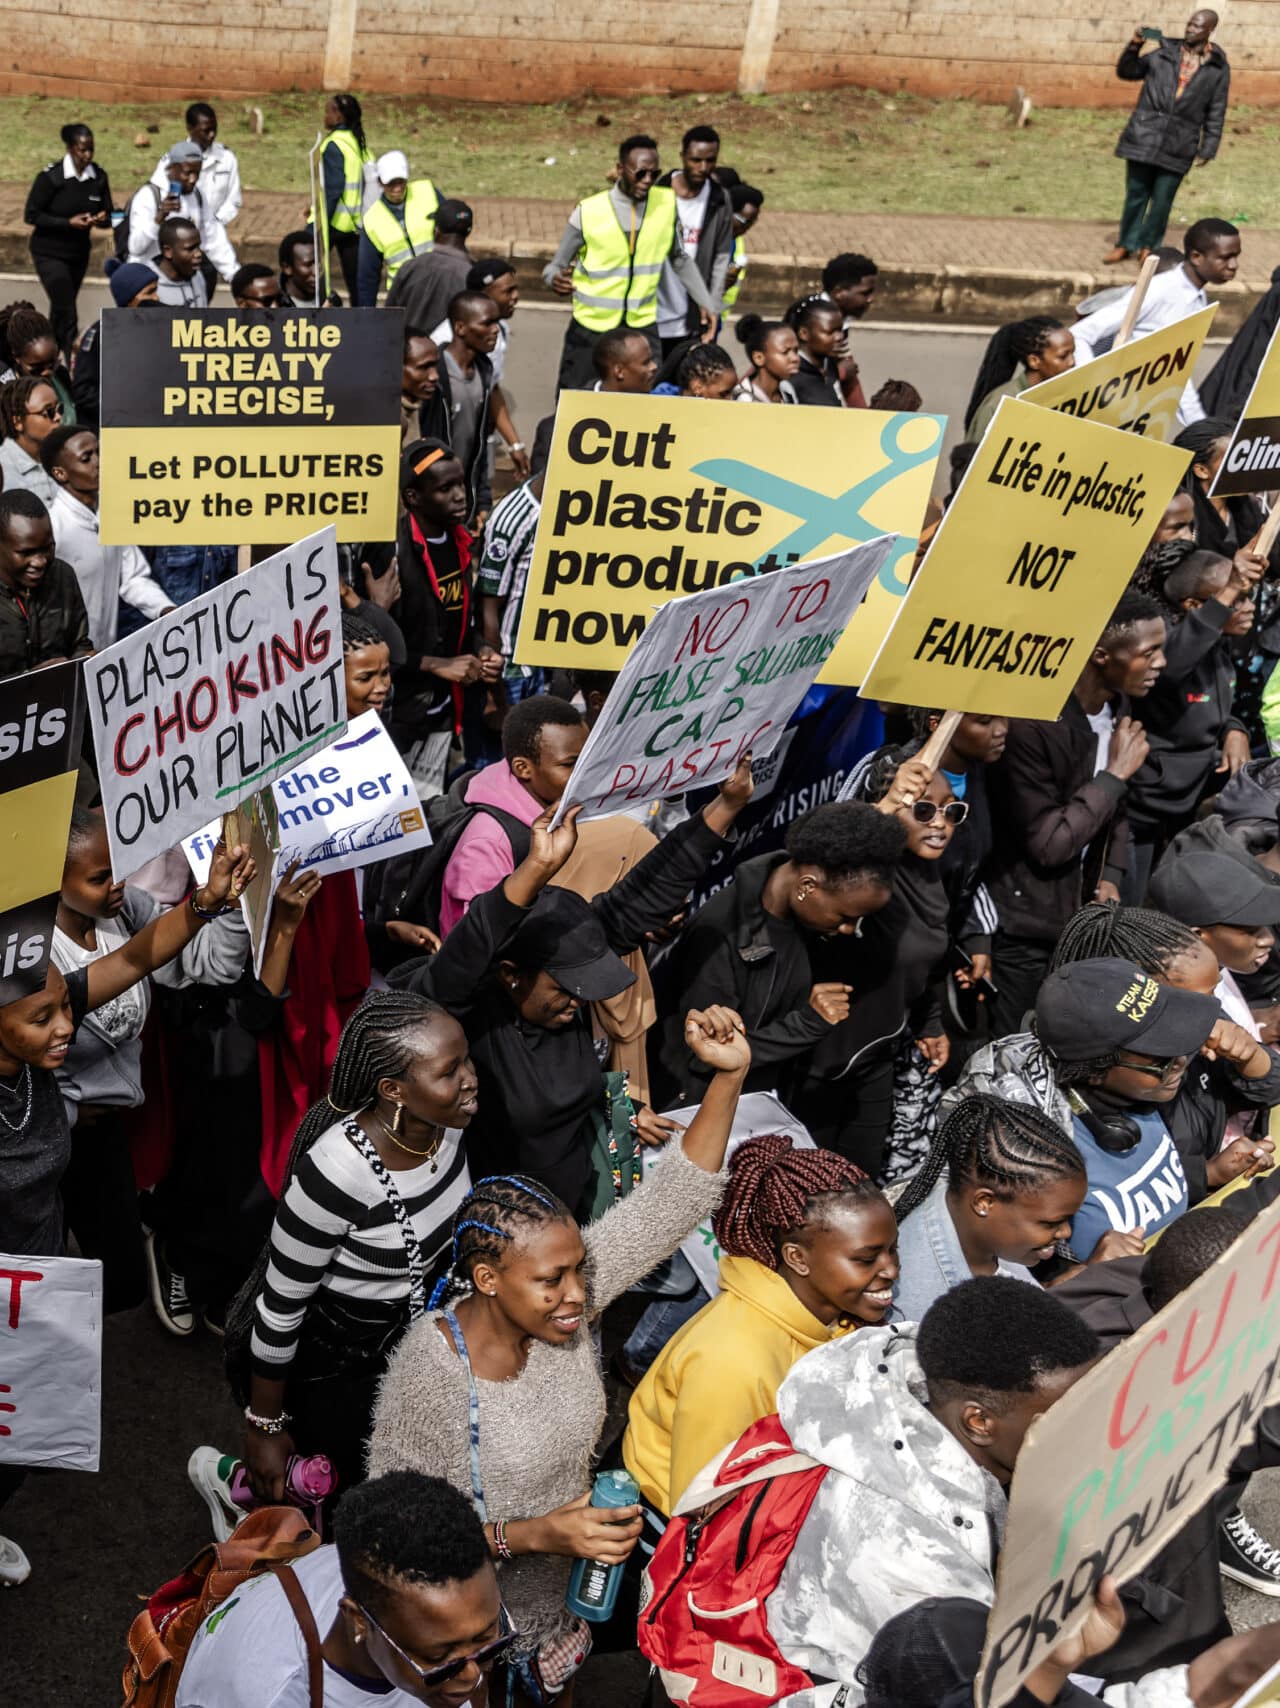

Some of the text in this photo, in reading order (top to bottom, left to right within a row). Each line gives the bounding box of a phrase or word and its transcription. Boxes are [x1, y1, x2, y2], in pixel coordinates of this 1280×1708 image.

[171, 317, 342, 349] Make the
[179, 352, 332, 382] TREATY
[163, 386, 335, 421] PRECISE,
[128, 453, 384, 480] Let POLLUTERS
[567, 417, 676, 469] Cut
[132, 491, 369, 524] pay the PRICE!
[553, 479, 763, 536] plastic
[987, 437, 1146, 527] Life in plastic,
[1006, 541, 1077, 592] NOT
[96, 546, 328, 727] PLASTIC IS
[674, 579, 831, 663] NO TO
[913, 617, 1075, 680] FANTASTIC!
[113, 604, 332, 777] CHOKING
[616, 629, 845, 725] FALSE SOLUTIONS
[115, 754, 199, 846] OUR
[215, 659, 343, 788] PLANET
[644, 697, 745, 758] CAP
[278, 766, 342, 799] the
[1120, 983, 1142, 1007] TEAM
